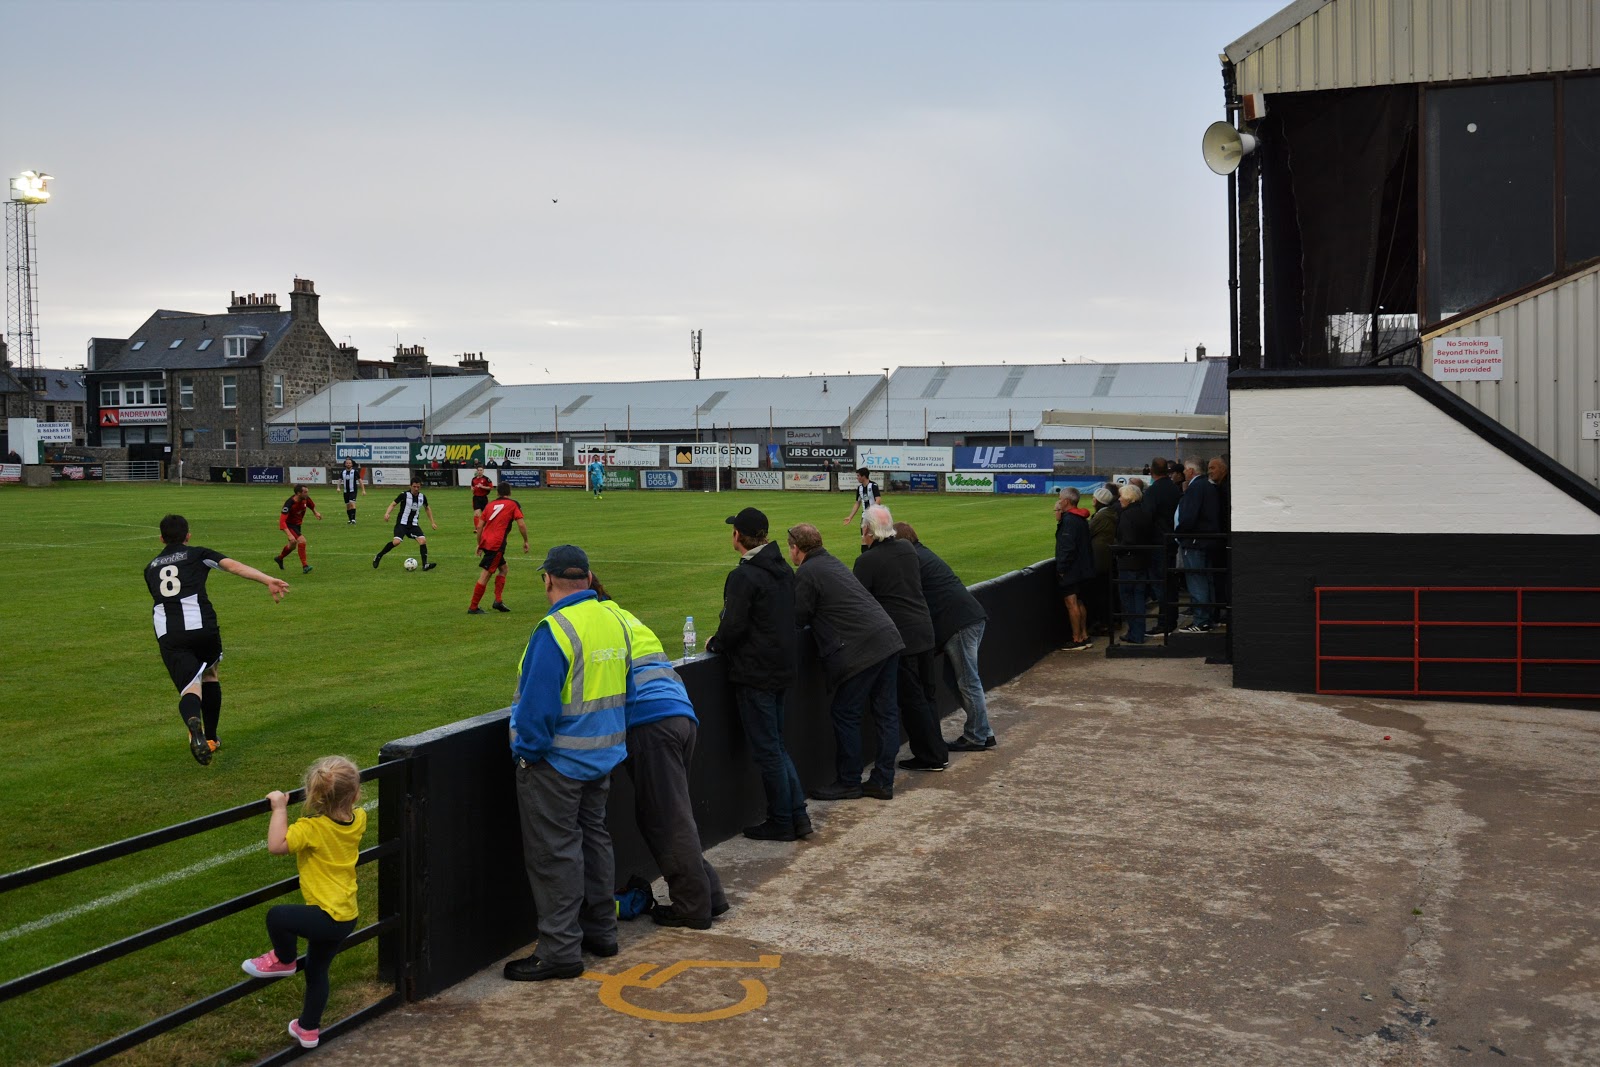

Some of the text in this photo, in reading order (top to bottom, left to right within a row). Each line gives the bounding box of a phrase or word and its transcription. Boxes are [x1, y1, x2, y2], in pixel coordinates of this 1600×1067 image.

[1460, 366, 1492, 374] provided
[269, 434, 290, 442] sound
[339, 448, 370, 457] CRUDENS
[415, 444, 481, 461] SUBWAY
[487, 448, 521, 458] newline
[694, 446, 752, 455] BRIDGEND
[811, 449, 847, 457] GROUP
[866, 456, 900, 465] STAR
[973, 446, 1006, 467] LJF
[489, 504, 505, 521] 7
[159, 565, 181, 597] 8
